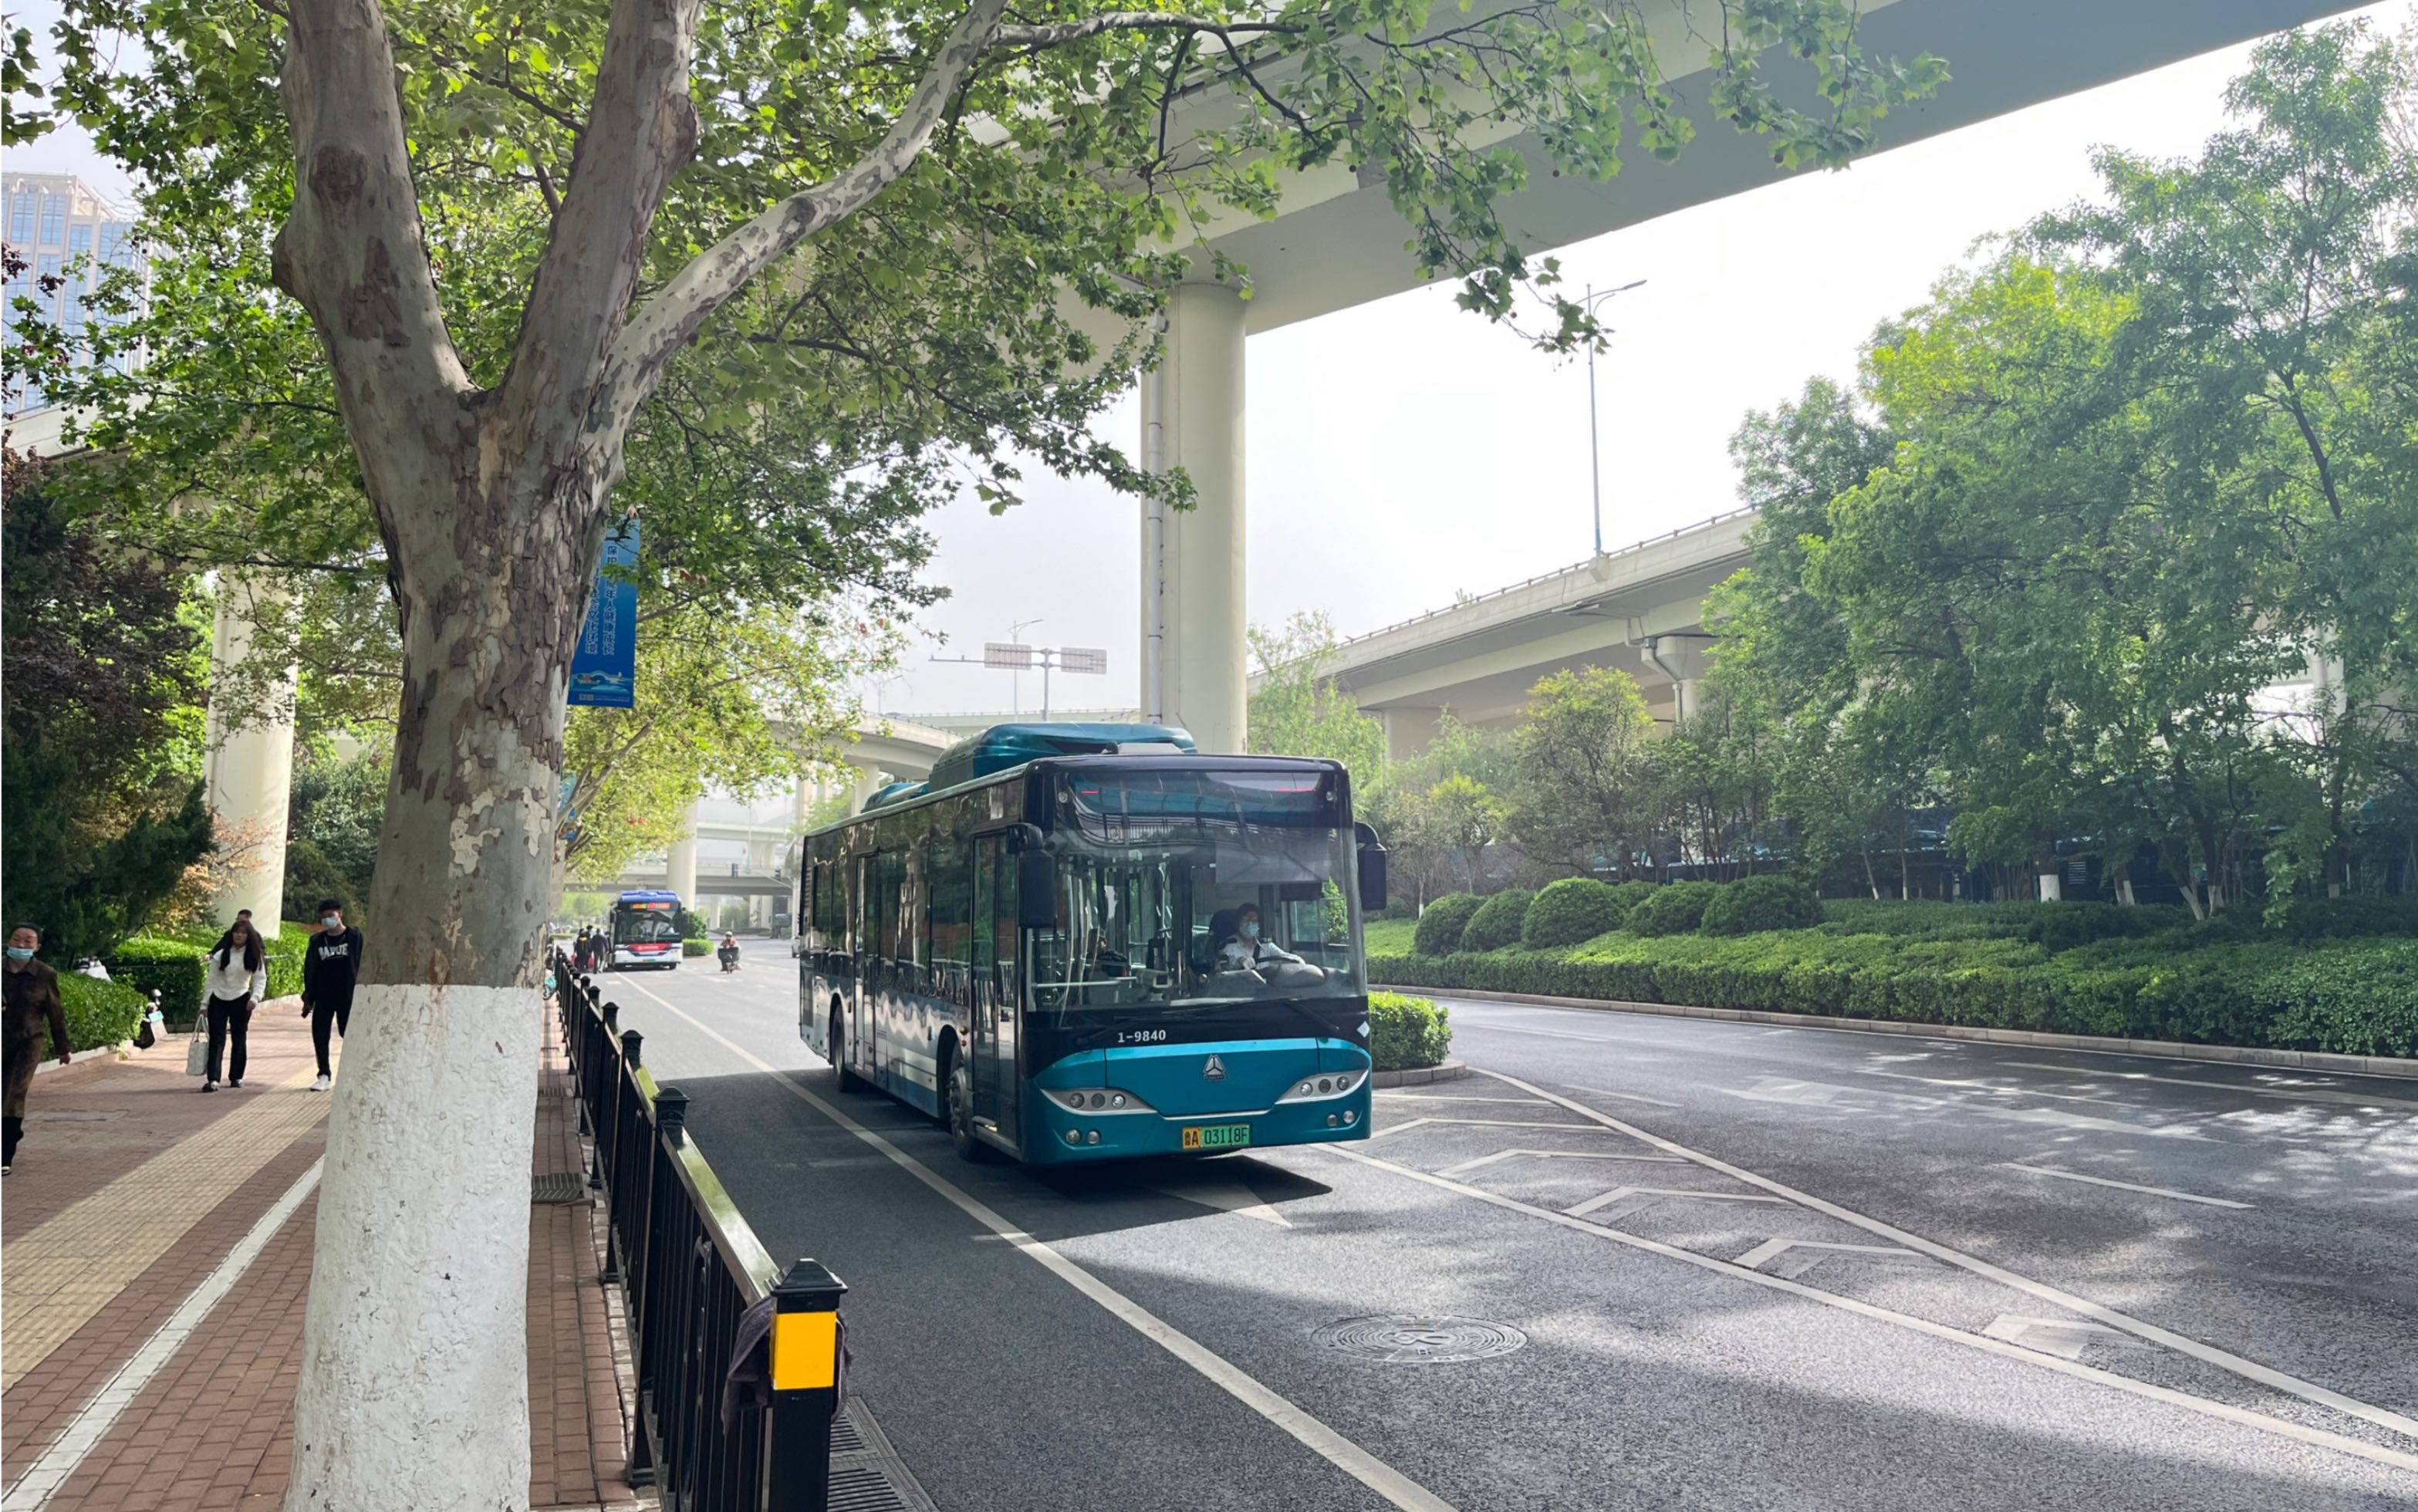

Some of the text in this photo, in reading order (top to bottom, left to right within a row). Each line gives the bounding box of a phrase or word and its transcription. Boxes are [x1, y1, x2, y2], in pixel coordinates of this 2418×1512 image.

[603, 545, 617, 655] 保护成年人健康成长
[1118, 1030, 1167, 1043] 1-9840
